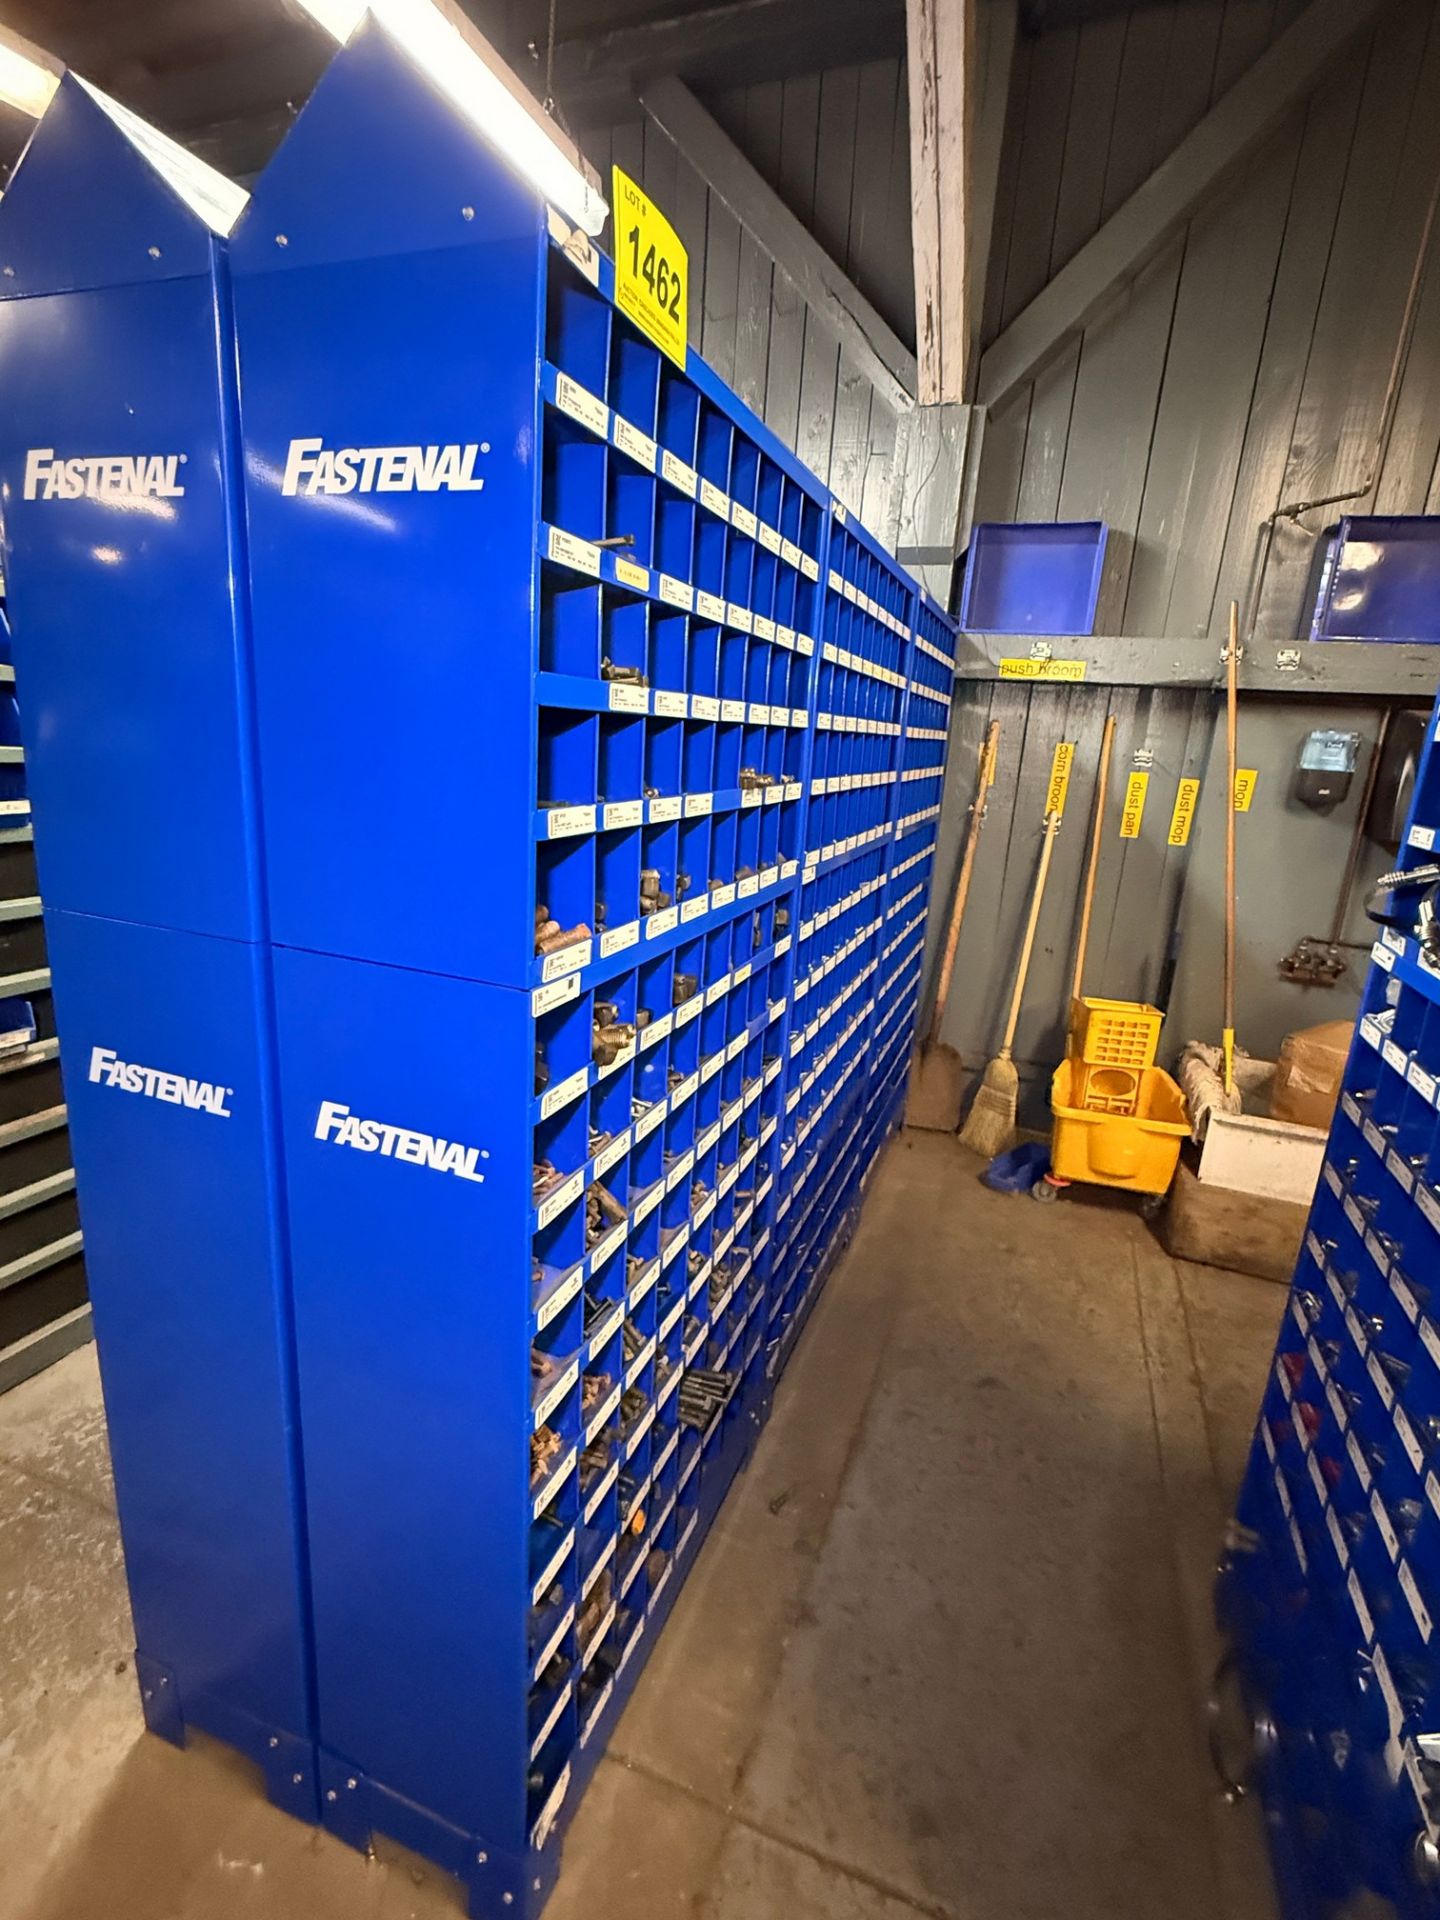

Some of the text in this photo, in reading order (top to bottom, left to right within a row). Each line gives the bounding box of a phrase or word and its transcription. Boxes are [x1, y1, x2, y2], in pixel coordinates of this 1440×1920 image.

[624, 184, 641, 211] LOT
[629, 225, 681, 325] 1462
[24, 448, 185, 500] FASTENAL
[281, 437, 485, 496] FASTENAL
[1001, 663, 1034, 676] push
[1055, 745, 1069, 773] corn
[1123, 781, 1143, 836] dust pan
[1170, 784, 1194, 844] dust mop
[1234, 779, 1249, 808] mop
[88, 1045, 231, 1118] FASTENAL
[314, 1100, 485, 1184] FASTENAL
